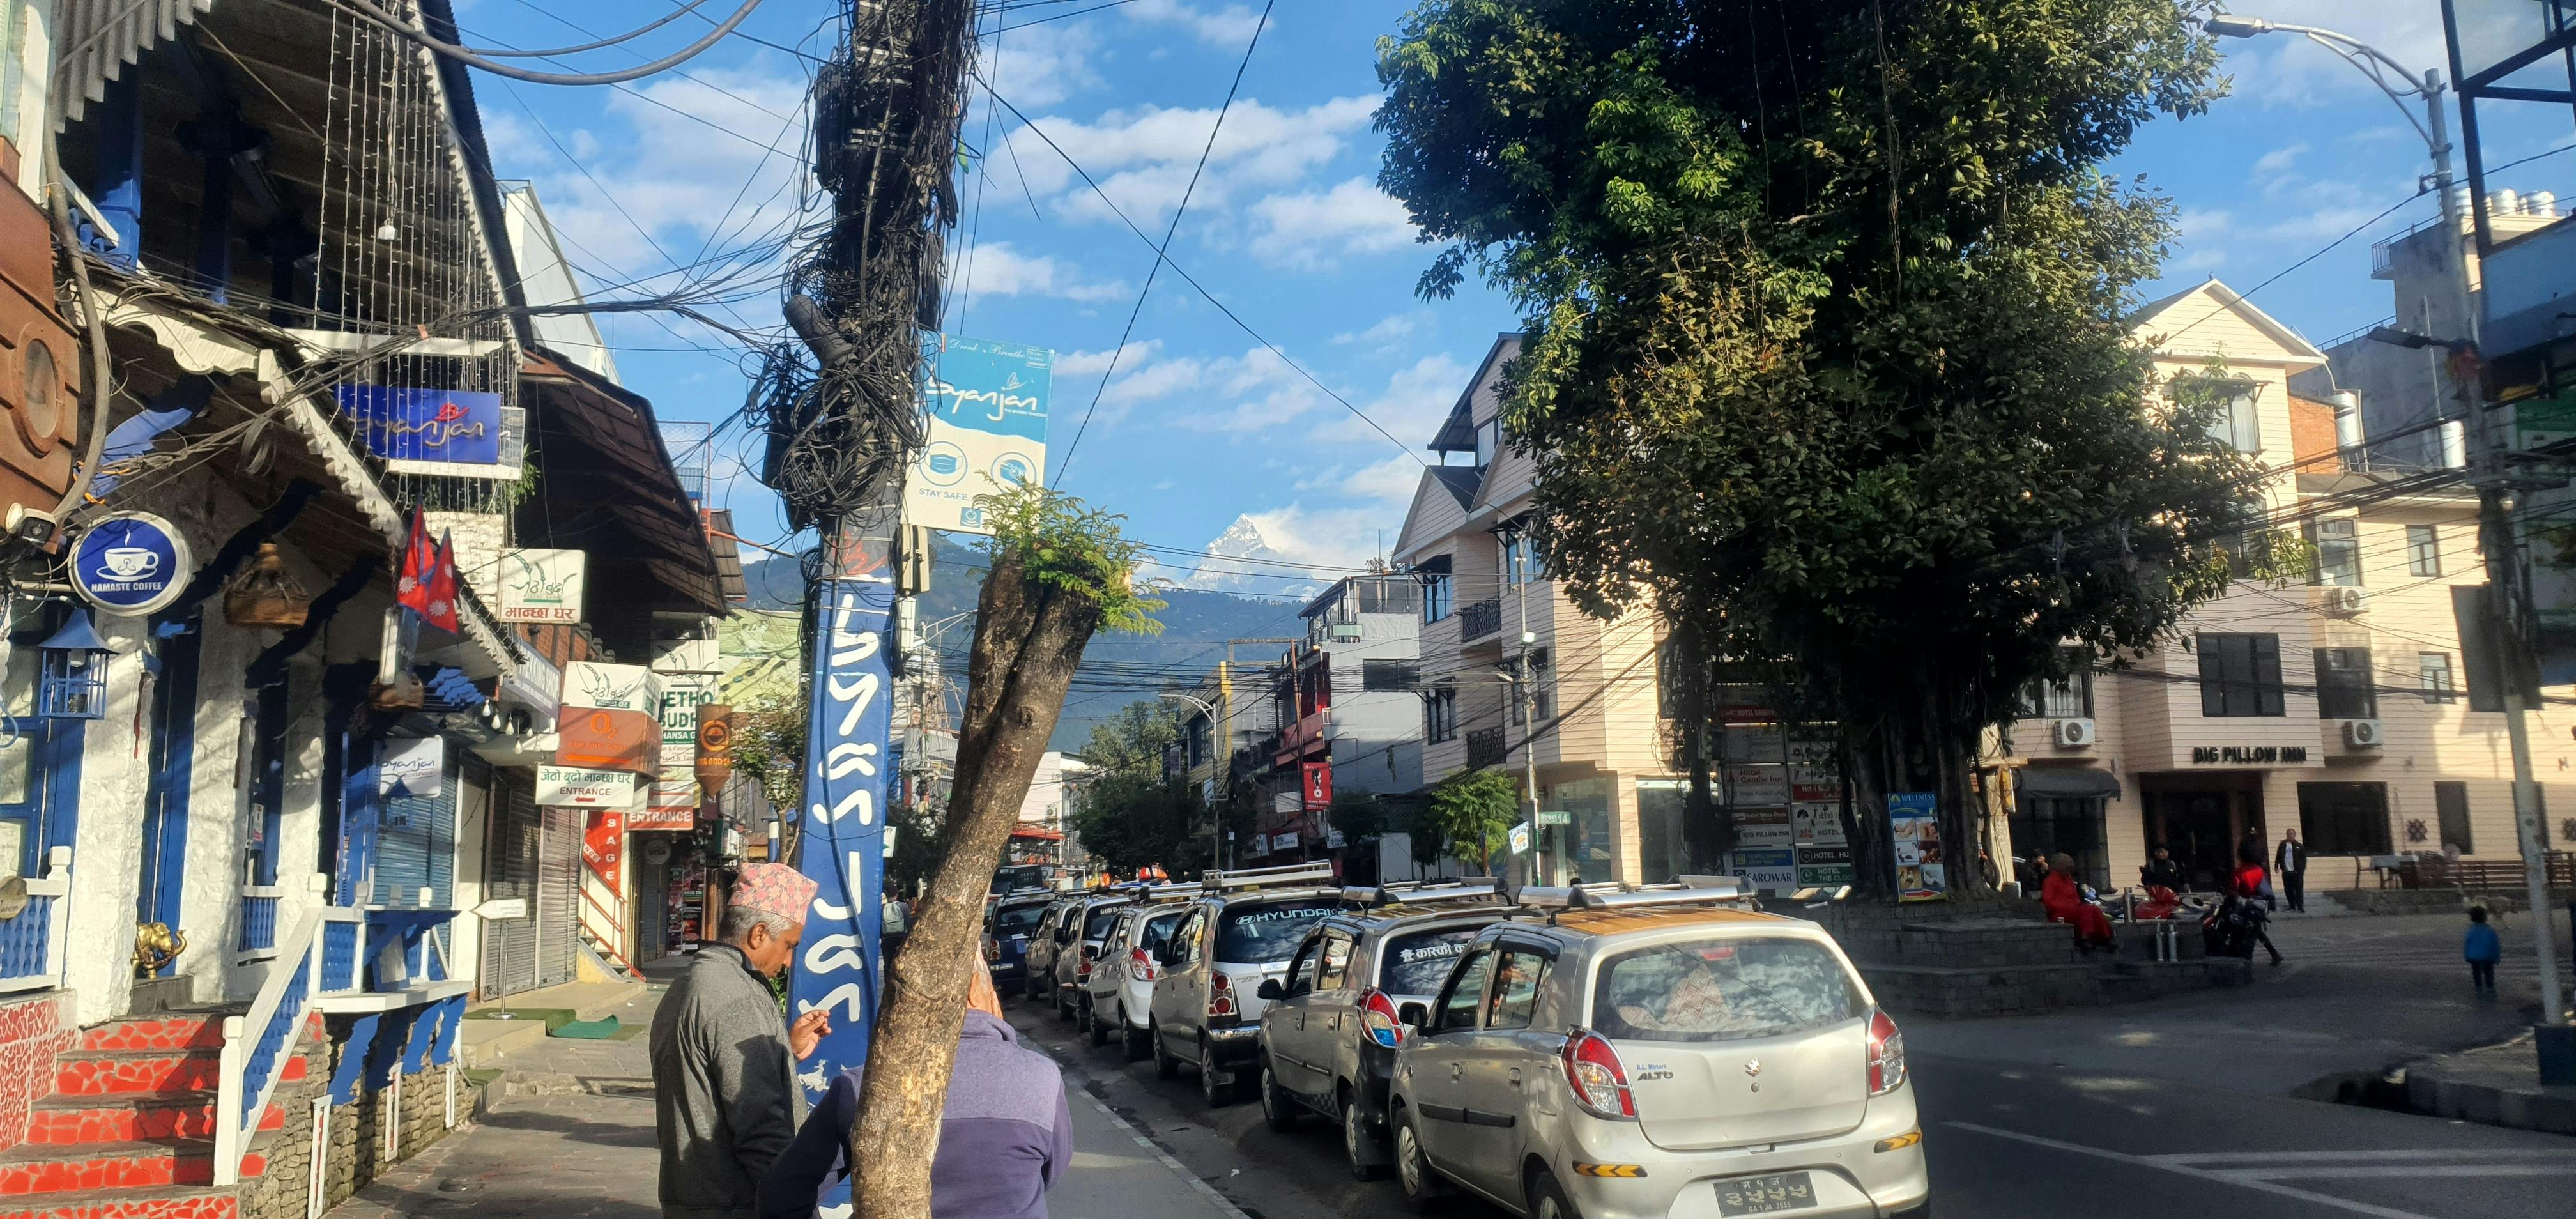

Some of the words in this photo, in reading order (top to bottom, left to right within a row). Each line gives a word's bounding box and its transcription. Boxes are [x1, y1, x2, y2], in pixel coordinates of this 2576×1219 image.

[919, 487, 941, 498] STAY
[91, 582, 130, 592] NAMASTE
[132, 581, 162, 591] COFFEE
[2193, 746, 2220, 763] BIG
[2222, 746, 2277, 763] PILLOW
[2281, 746, 2307, 763] INN
[560, 786, 611, 796] ENTRANCE
[1901, 793, 1936, 802] WELLNESS
[629, 810, 692, 823] ENTRANCE
[1540, 813, 1557, 822] Street
[1558, 813, 1568, 823] 14
[1747, 872, 1792, 883] SAROWAR
[1256, 908, 1331, 923] HYUNDAI
[1415, 942, 1452, 958] कास्की
[1637, 1071, 1674, 1081] ALTO
